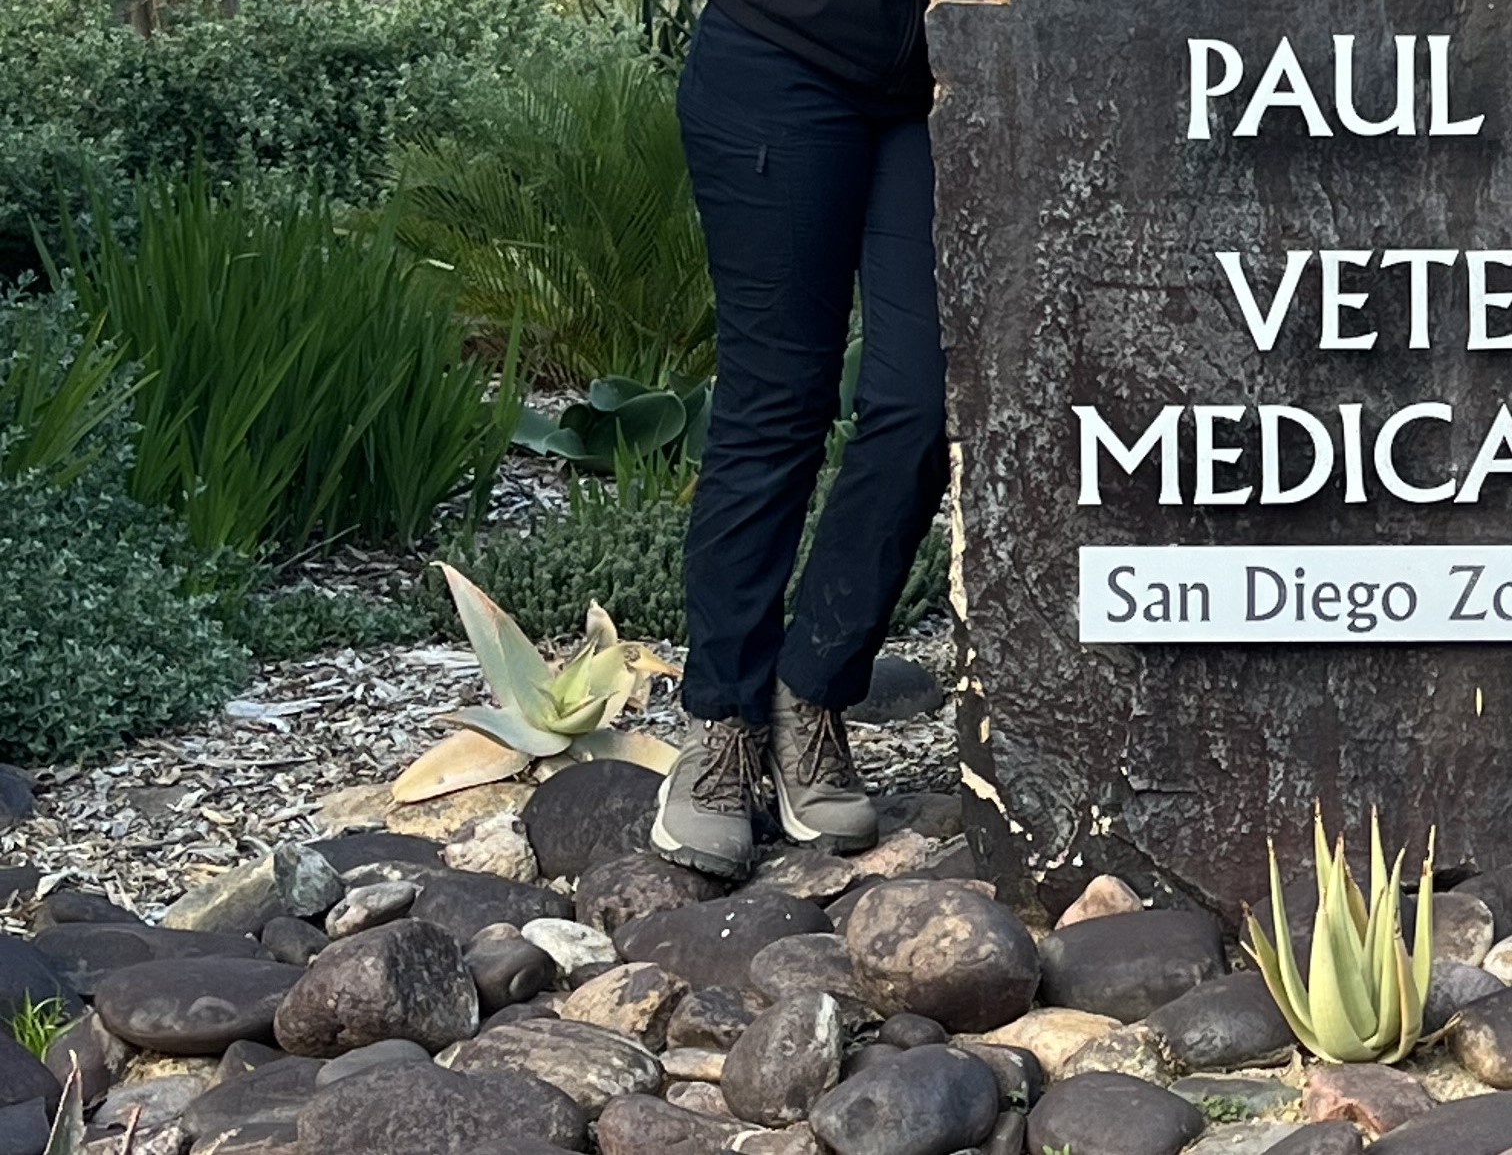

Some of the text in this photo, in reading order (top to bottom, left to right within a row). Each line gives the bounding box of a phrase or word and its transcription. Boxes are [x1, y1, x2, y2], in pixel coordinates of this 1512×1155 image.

[1188, 34, 1485, 139] PAUL
[1108, 566, 1210, 622] San
[1246, 566, 1418, 634] Diego
